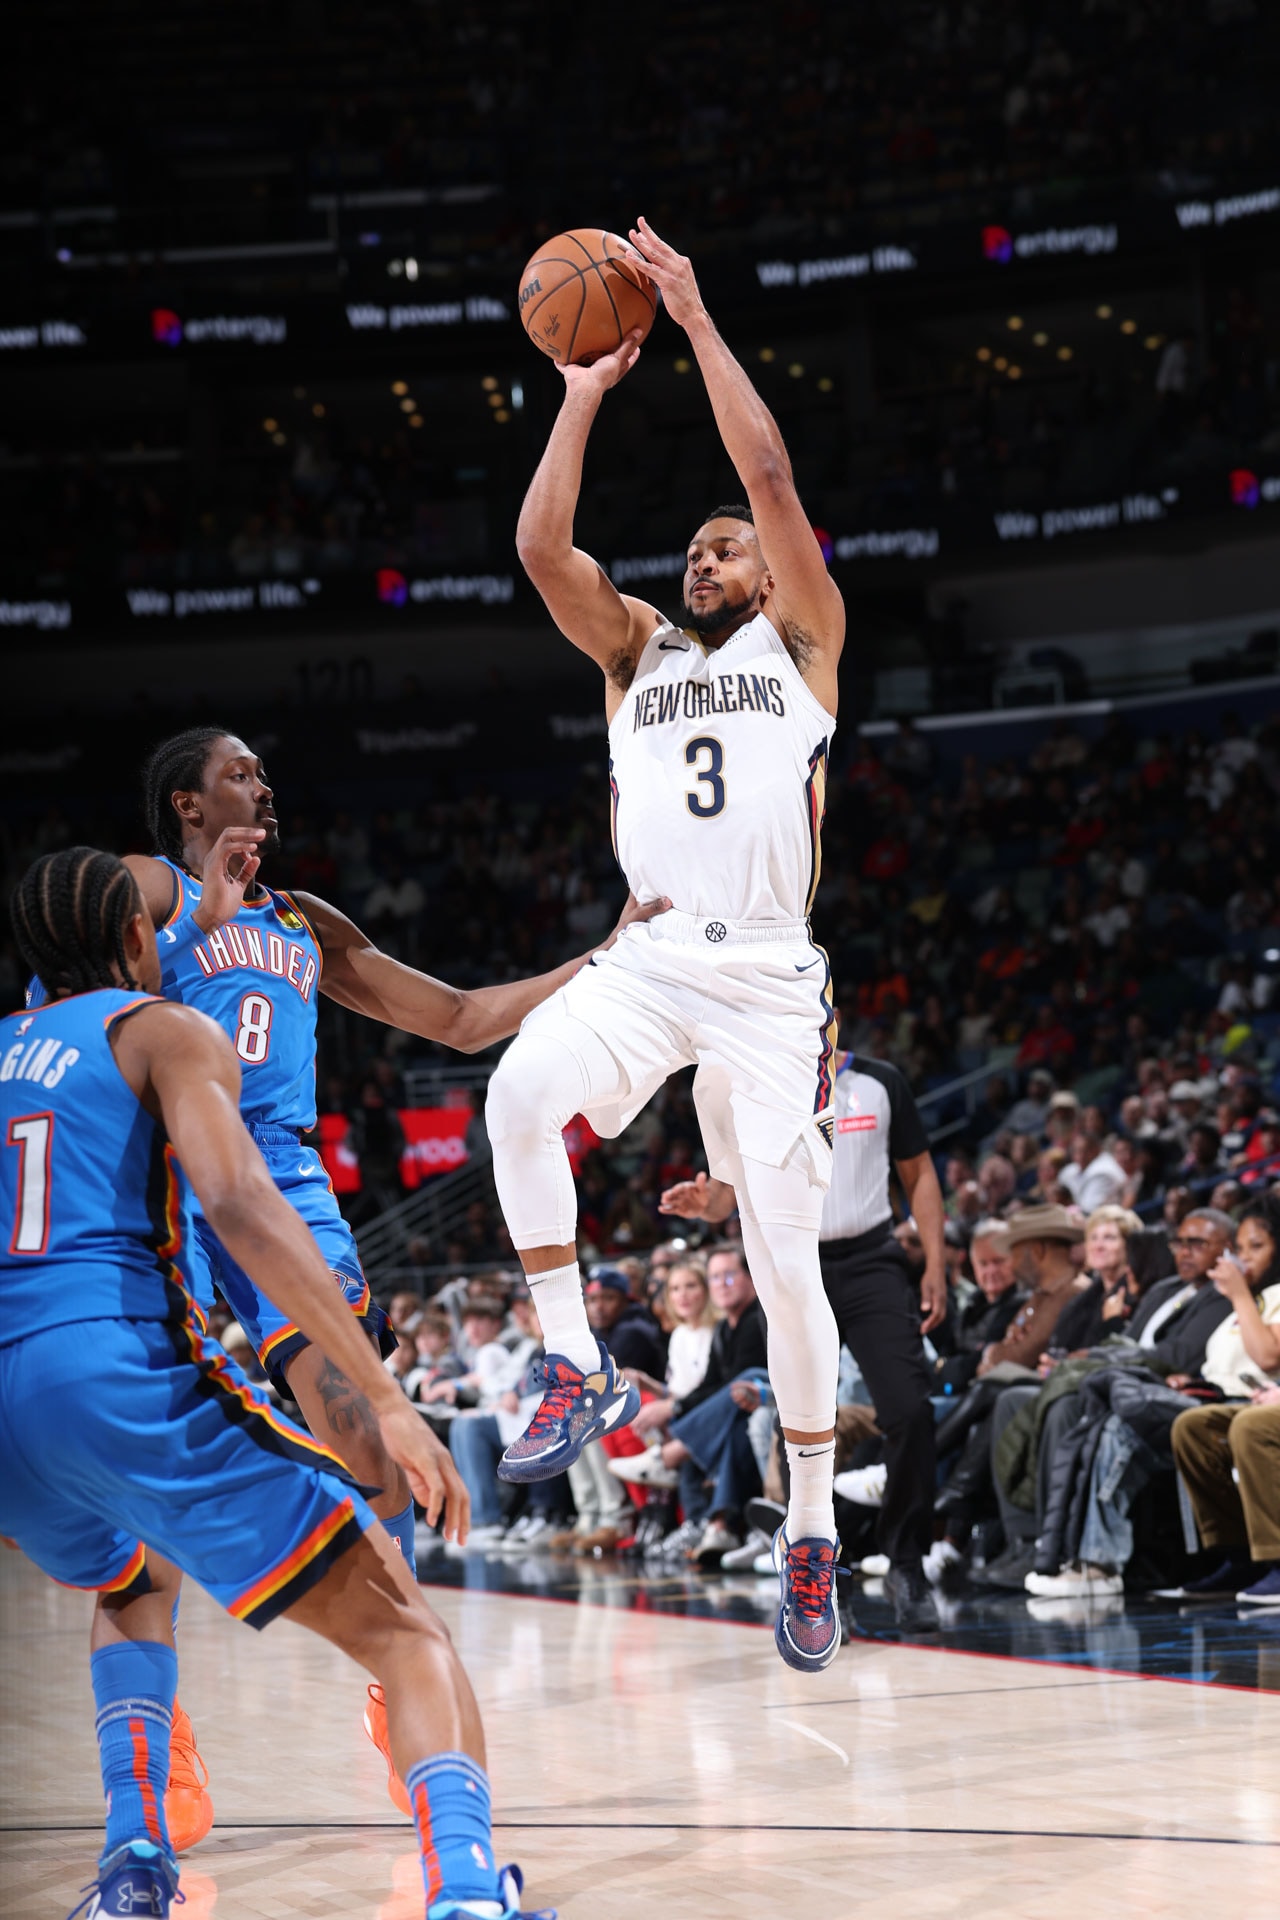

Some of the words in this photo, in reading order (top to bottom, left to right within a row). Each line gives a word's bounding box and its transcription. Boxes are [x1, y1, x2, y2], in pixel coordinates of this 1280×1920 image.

[1013, 223, 1118, 258] entergy
[756, 261, 796, 288] We
[797, 254, 871, 287] power
[183, 315, 287, 345] entergy
[346, 303, 387, 329] We
[388, 302, 463, 330] power
[1041, 502, 1120, 539] power
[834, 528, 939, 560] entergy
[173, 587, 254, 618] power
[409, 574, 514, 605] entergy
[632, 681, 683, 734] NEW
[682, 672, 786, 720] ORLEANS
[684, 734, 727, 820] 3
[234, 991, 273, 1065] 8
[0, 1038, 80, 1089] GINS
[6, 1111, 54, 1255] 1
